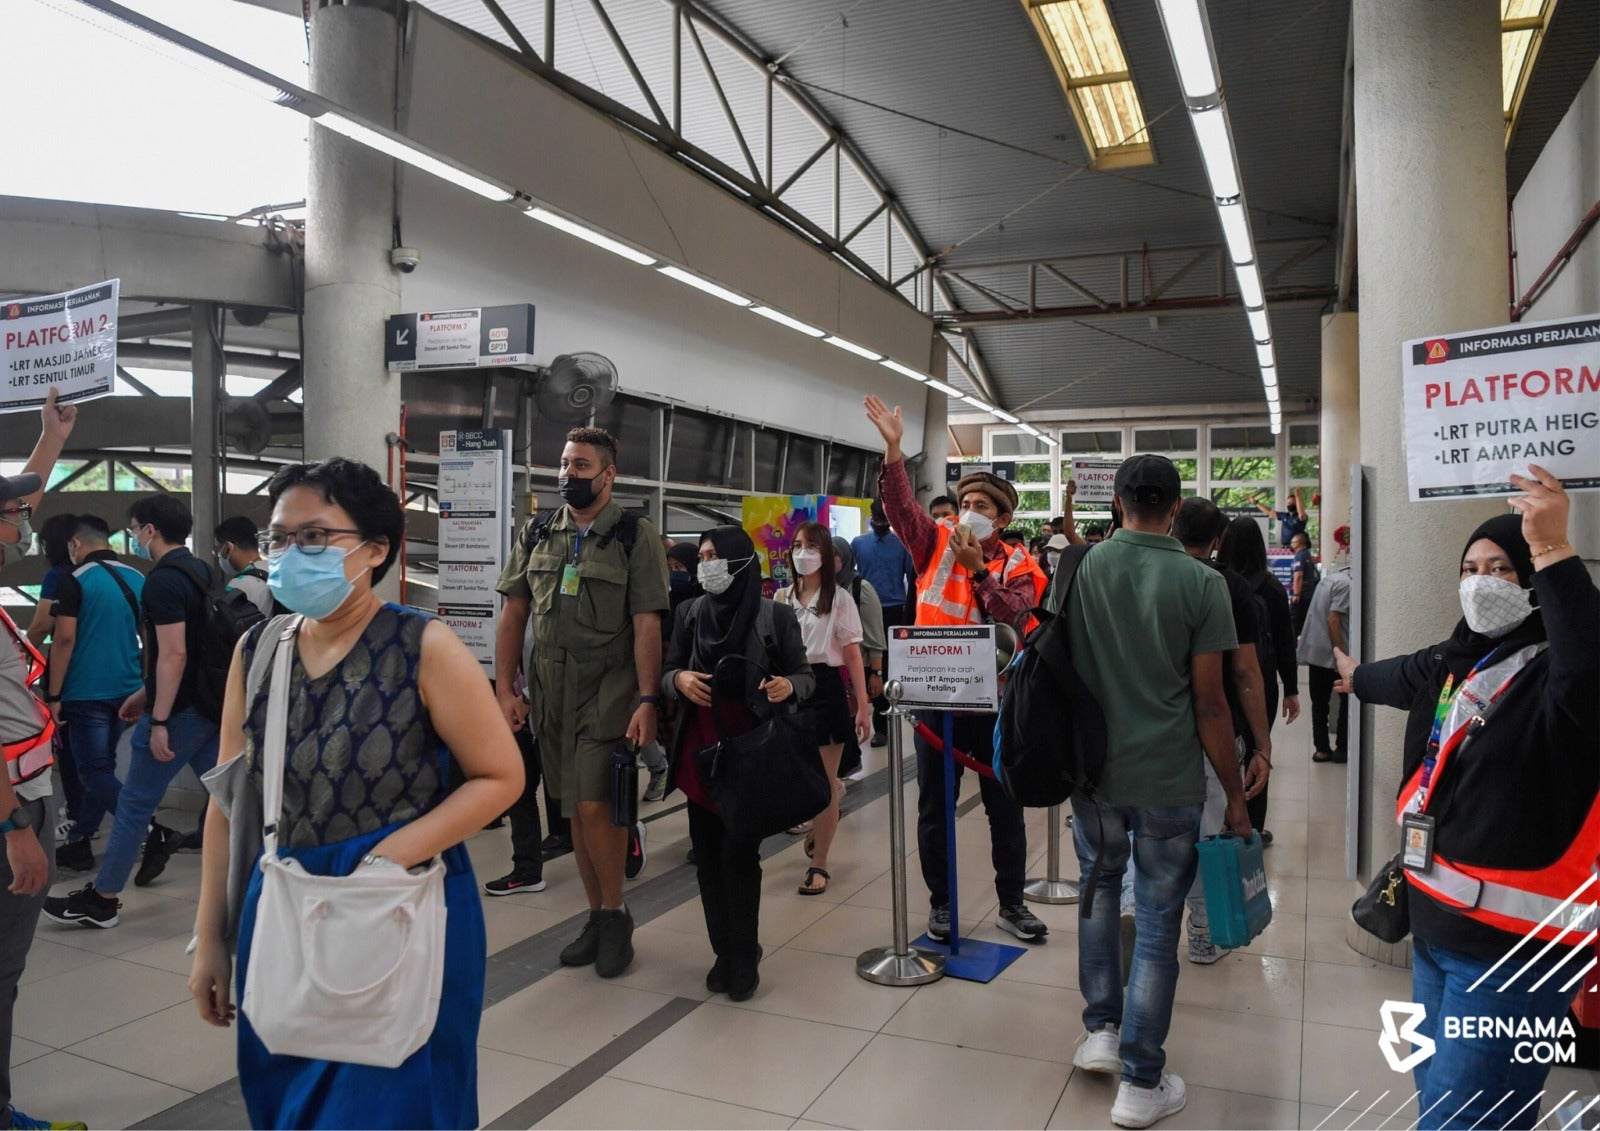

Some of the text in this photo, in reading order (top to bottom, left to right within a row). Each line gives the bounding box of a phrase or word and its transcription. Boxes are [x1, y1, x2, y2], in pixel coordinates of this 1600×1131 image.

[27, 302, 64, 313] INFORMASI
[6, 314, 108, 350] PLATFORM 2
[430, 324, 462, 332] PLATFORM
[1459, 337, 1532, 353] INFORMASI
[13, 359, 30, 371] LRT
[33, 354, 72, 369] MASJID
[12, 363, 95, 387] LRT SENTUL TIMUR
[1425, 365, 1600, 409] PLATFORM
[1441, 423, 1469, 441] LRT
[1475, 417, 1538, 438] PUTRA
[1442, 439, 1576, 465] LRT AMPANG
[446, 620, 477, 628] PLATFORM
[909, 645, 971, 656] PLATFORM 1
[907, 665, 946, 673] Perjalanan
[947, 665, 957, 673] ke
[900, 675, 924, 683] Stesen
[974, 676, 984, 684] Sri
